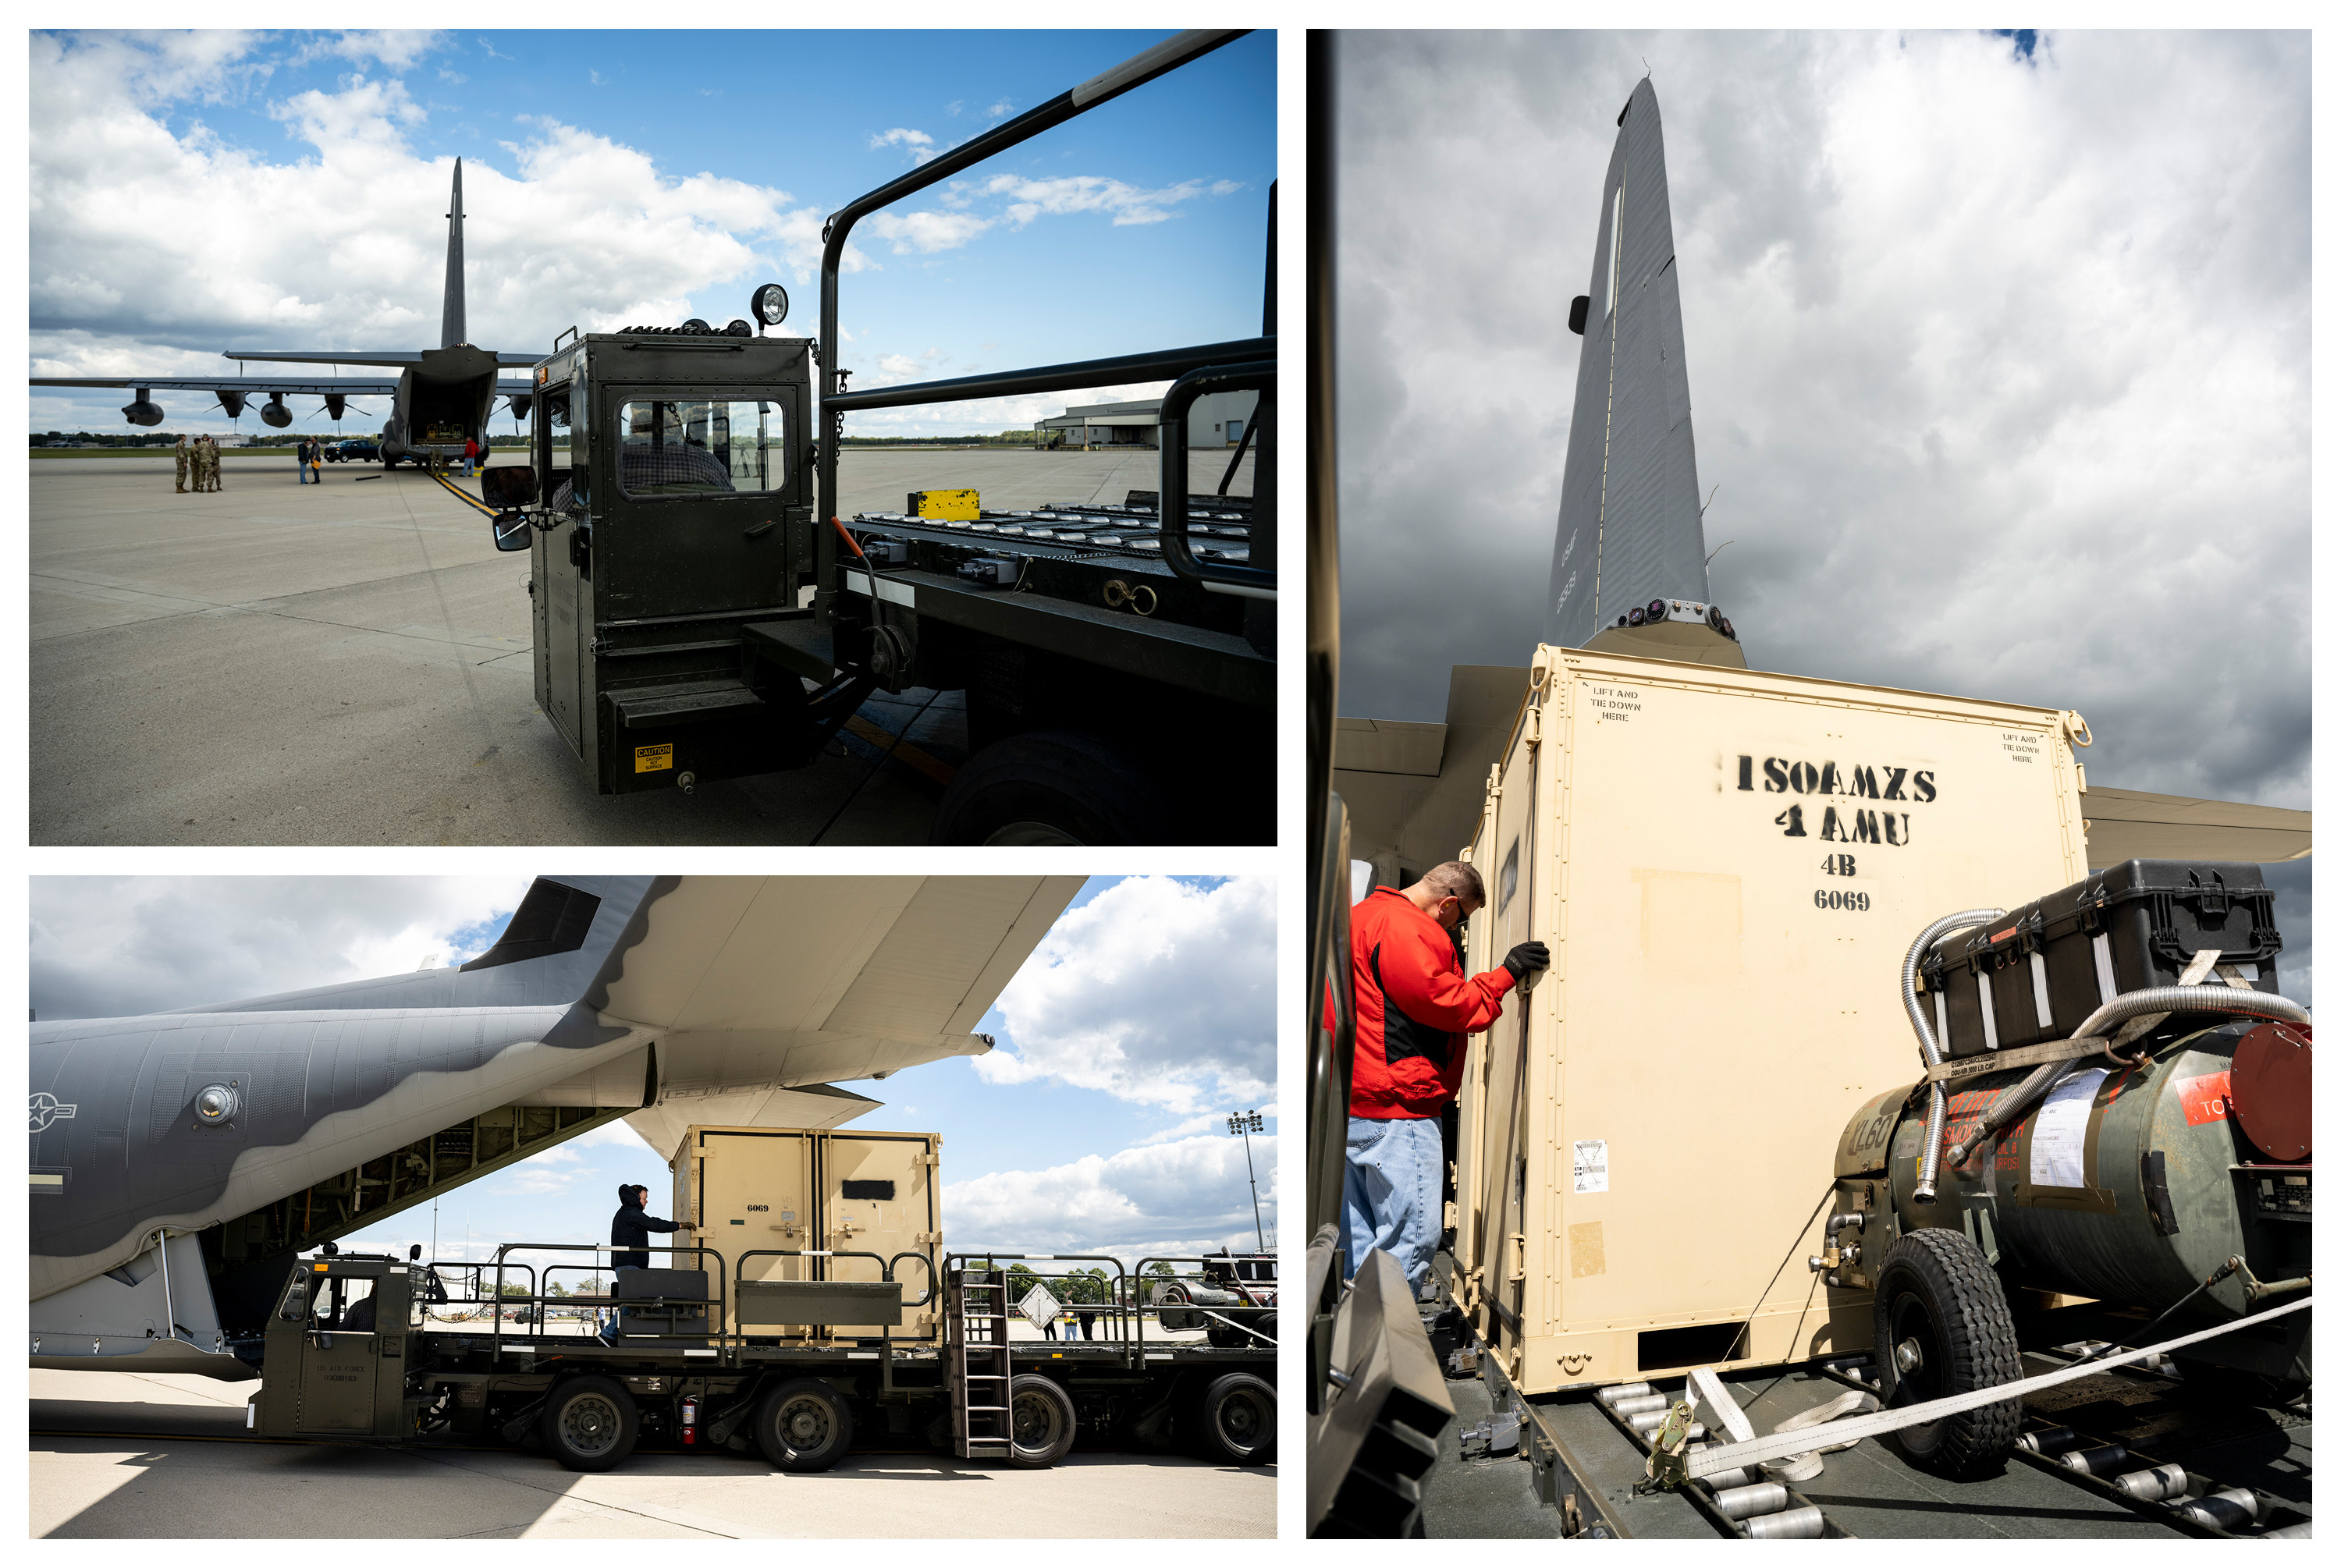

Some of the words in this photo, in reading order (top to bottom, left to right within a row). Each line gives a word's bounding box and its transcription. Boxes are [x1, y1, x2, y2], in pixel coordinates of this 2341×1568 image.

[1561, 528, 1577, 568] USAF
[1593, 687, 1614, 699] LIFT
[1617, 690, 1639, 699] AND
[1591, 698, 1606, 708] TIE
[1609, 701, 1641, 711] DOWN
[1602, 711, 1629, 722] HERE
[2002, 733, 2019, 742] LIFT
[638, 746, 670, 757] CAUTION
[2002, 743, 2016, 752] TIE
[2016, 745, 2040, 755] DOWN
[2012, 754, 2033, 764] HERE
[1774, 804, 1808, 838] 4
[1820, 807, 1910, 846] AMU
[1821, 853, 1856, 877] 4B
[1814, 889, 1870, 912] 6069
[1985, 1062, 1995, 1070] CAP
[1847, 1114, 1893, 1156] XL60
[1998, 1142, 2009, 1155] OIL
[2012, 1141, 2017, 1154] &
[747, 1204, 769, 1214] 6069
